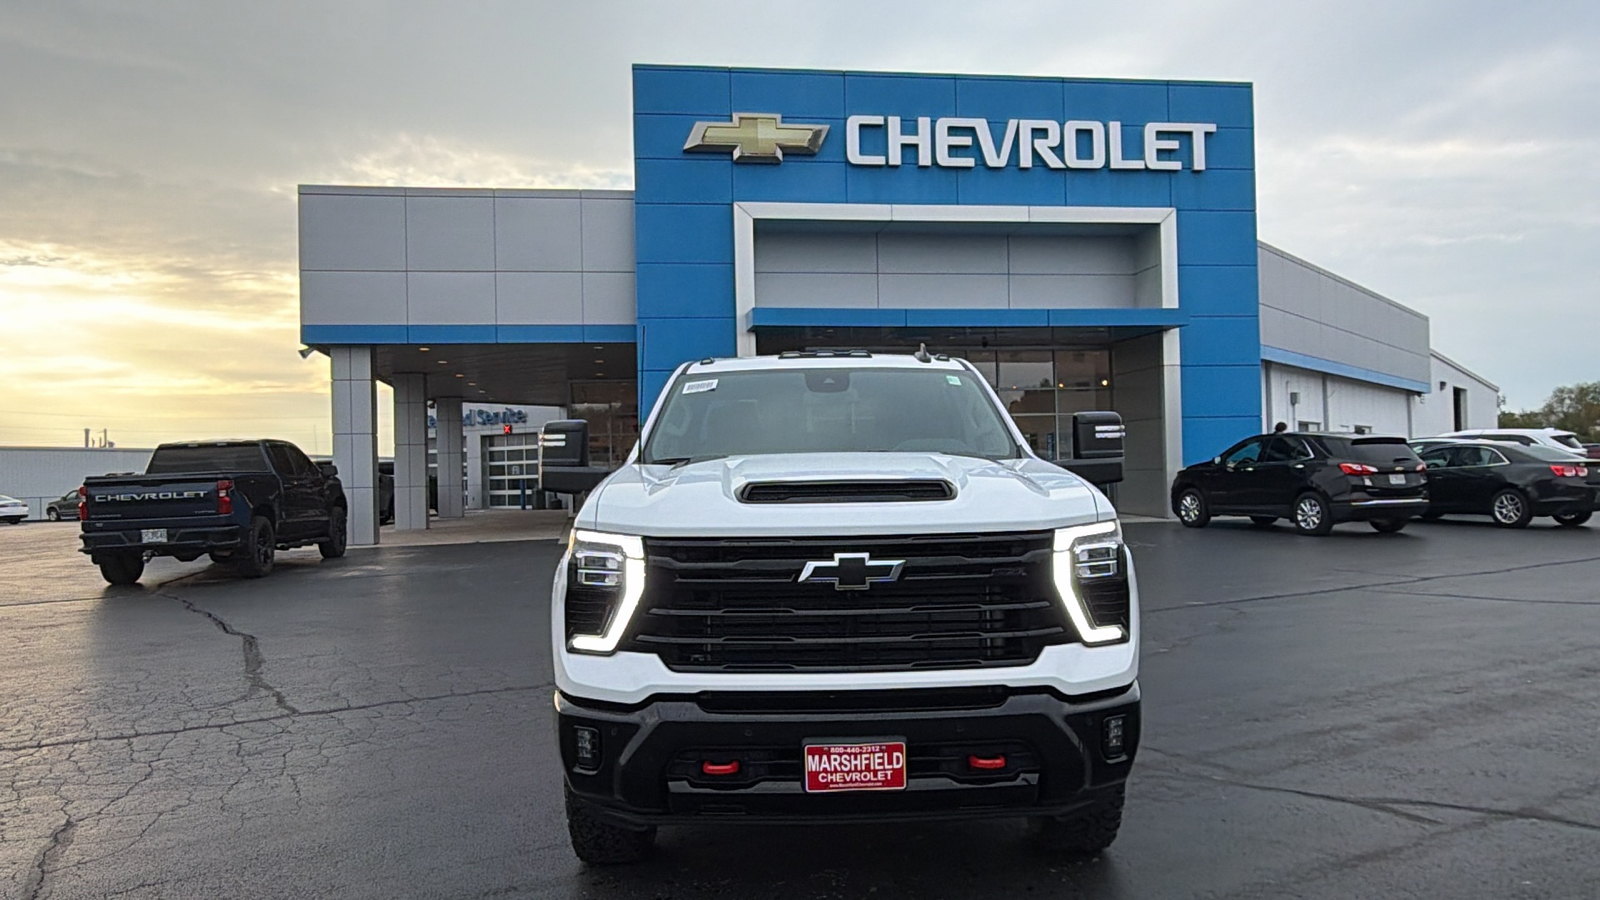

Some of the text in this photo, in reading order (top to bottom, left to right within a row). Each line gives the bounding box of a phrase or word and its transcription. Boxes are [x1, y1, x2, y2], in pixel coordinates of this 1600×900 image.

[846, 115, 1217, 172] CHEVROLET
[95, 491, 206, 502] CHEVROLET
[808, 752, 903, 772] MARSHFIELD
[818, 771, 893, 782] CHEVROLET
